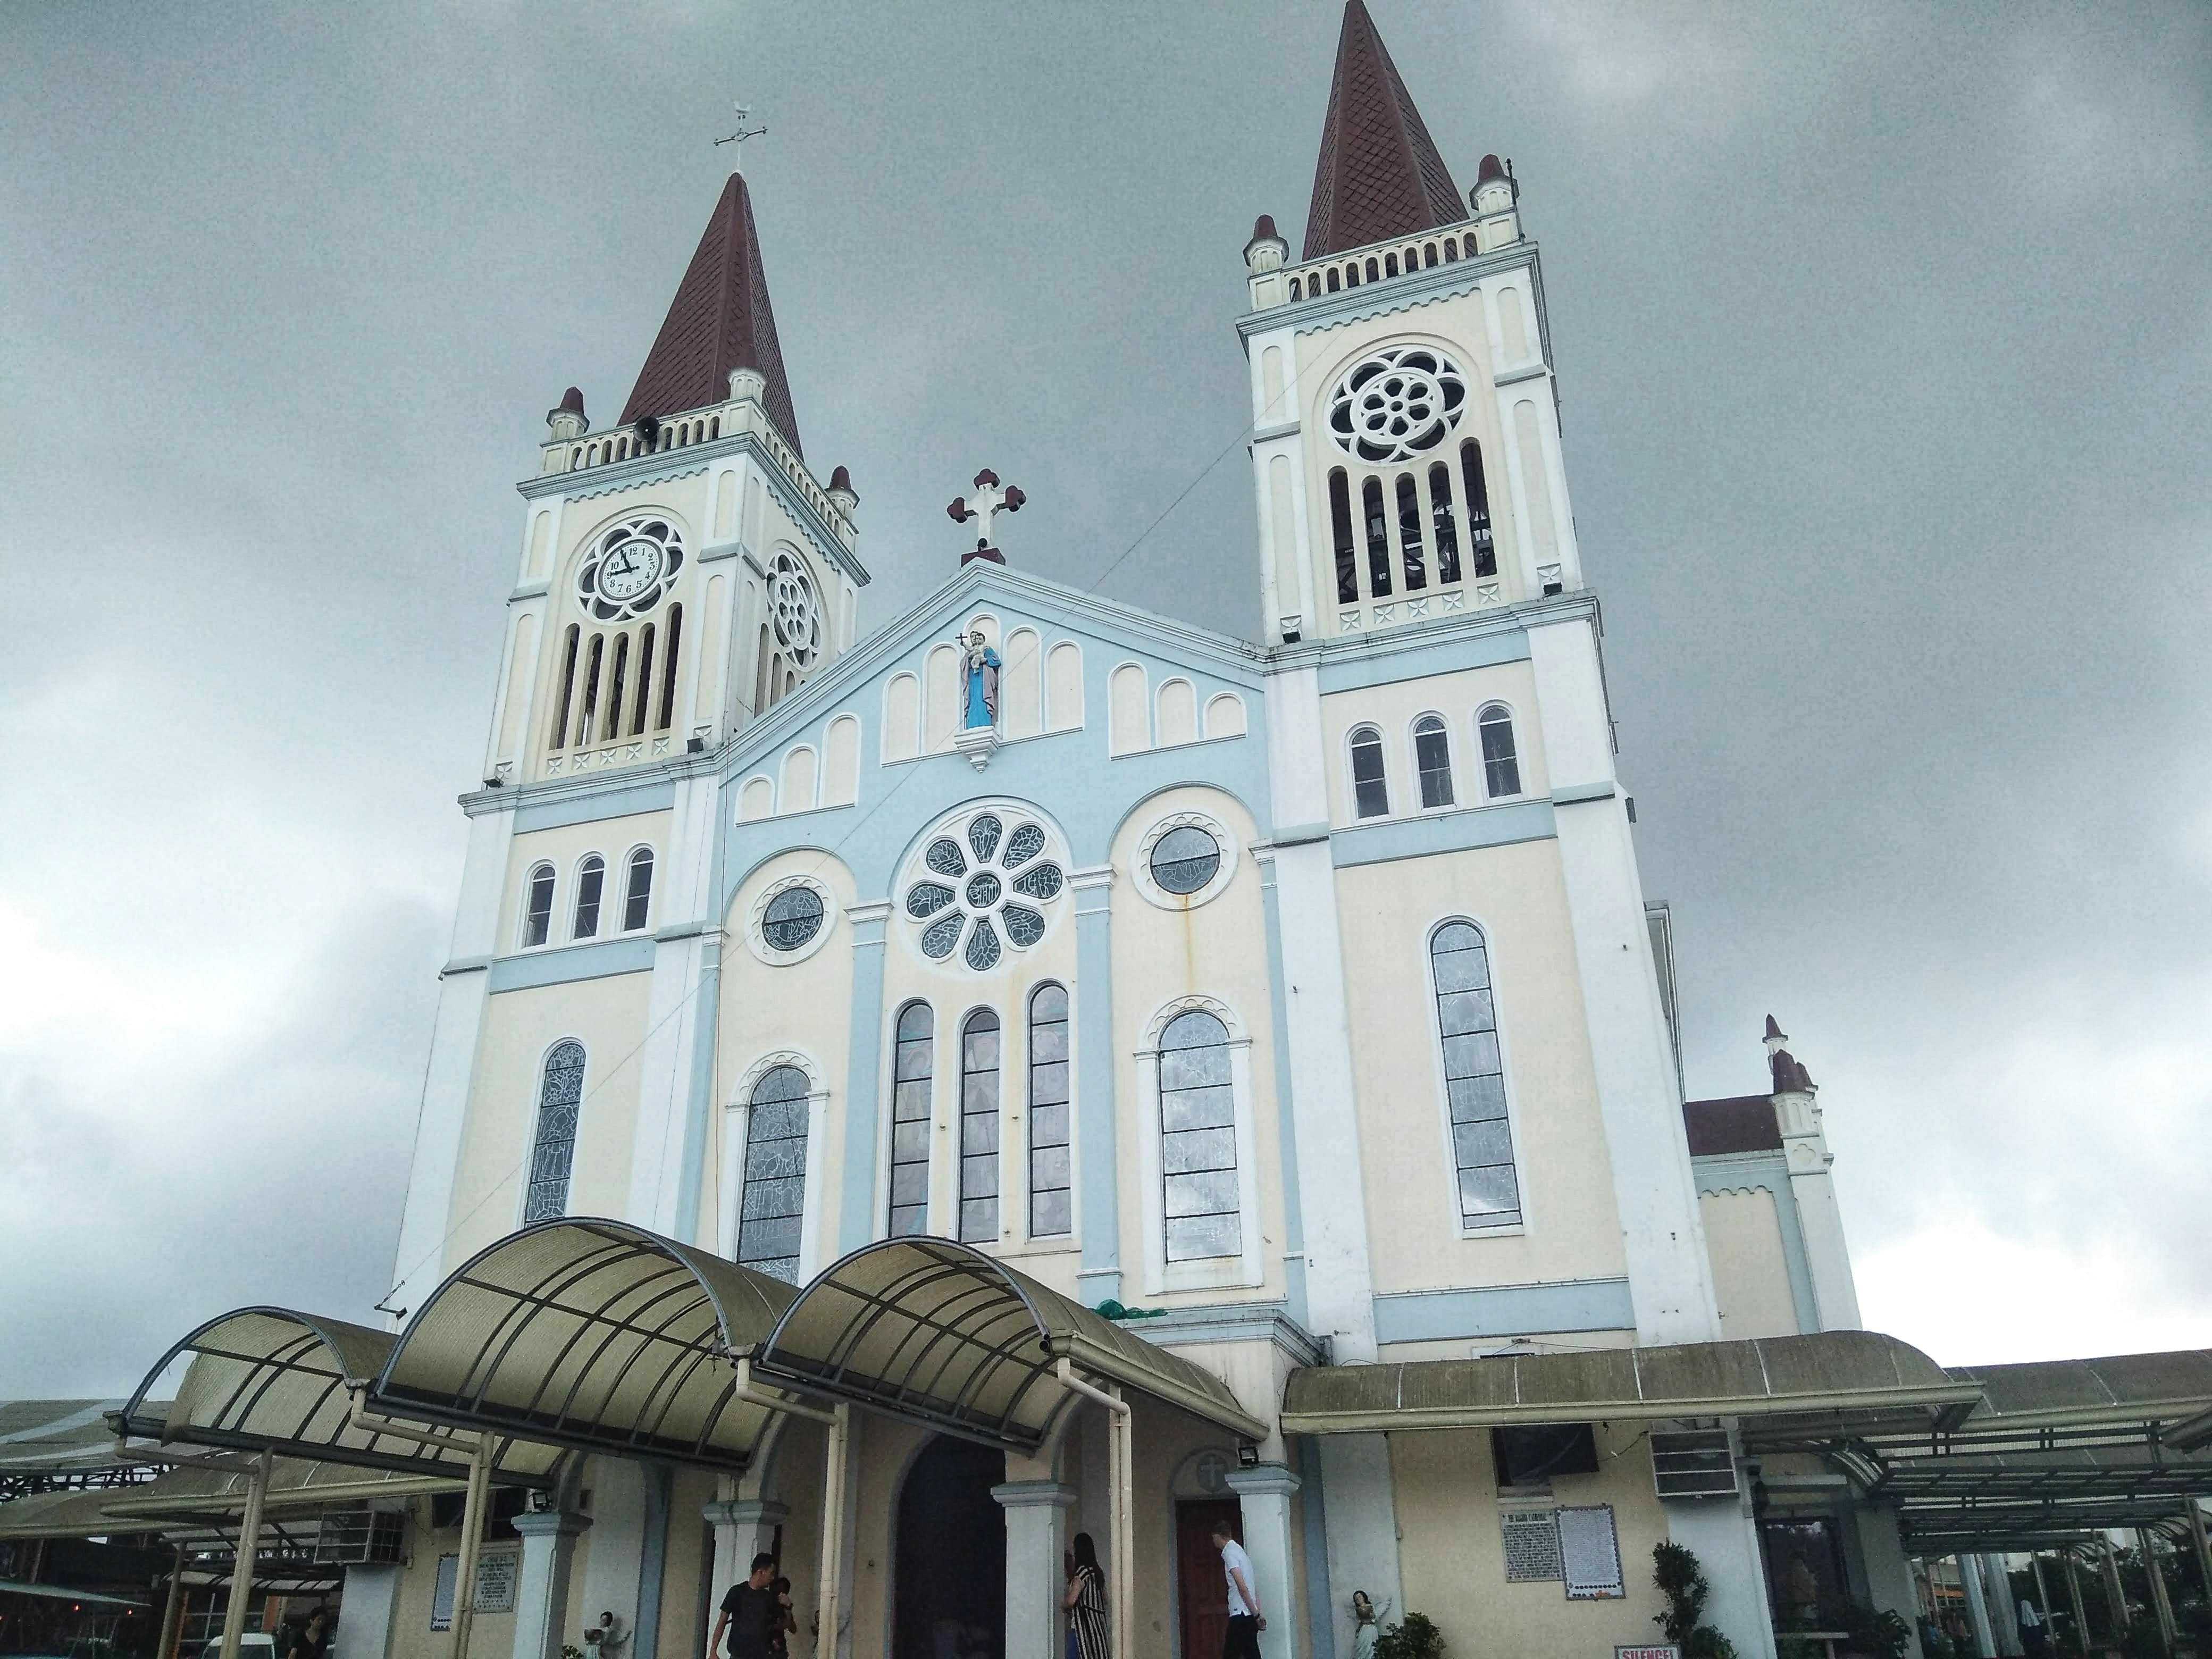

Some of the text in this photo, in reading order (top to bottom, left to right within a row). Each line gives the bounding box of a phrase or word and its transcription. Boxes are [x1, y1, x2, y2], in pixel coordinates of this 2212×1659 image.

[629, 547, 638, 556] 12
[610, 561, 619, 570] 10
[607, 571, 612, 580] 9
[645, 571, 650, 580] 4
[609, 579, 615, 588] 8
[617, 583, 623, 592] 7
[636, 580, 642, 588] 5
[626, 584, 631, 593] 6
